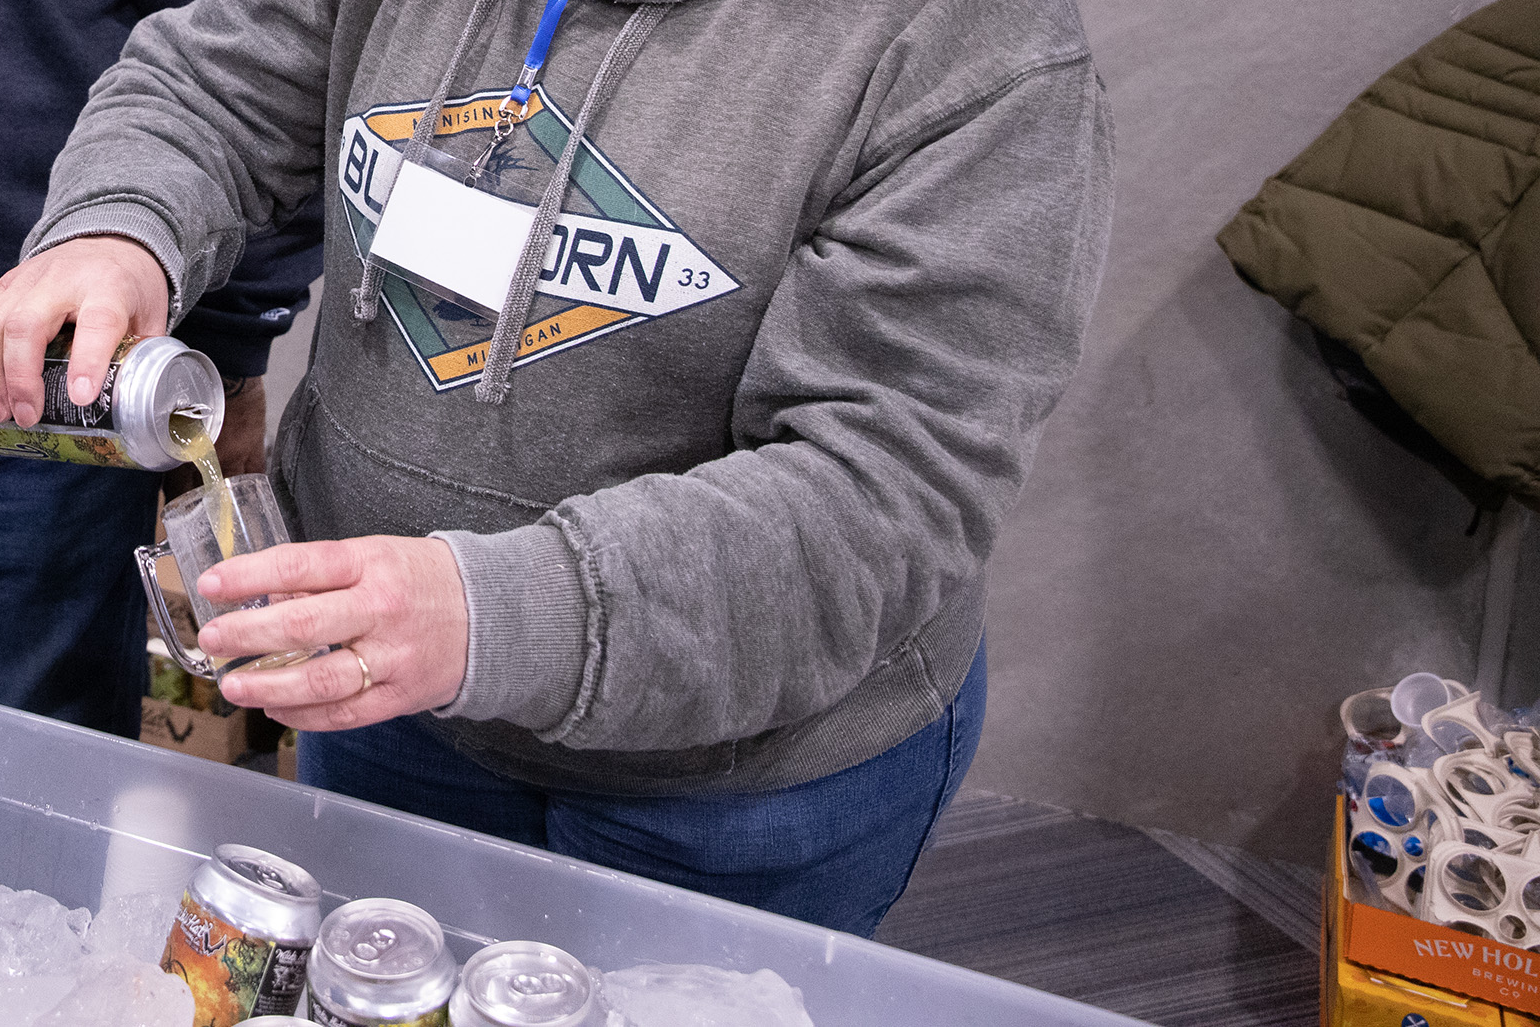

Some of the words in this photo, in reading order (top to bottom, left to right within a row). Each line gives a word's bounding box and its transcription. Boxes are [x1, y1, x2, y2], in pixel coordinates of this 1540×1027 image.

[677, 267, 712, 290] 33
[466, 322, 562, 367] MIIGAN
[1413, 939, 1474, 959] NEW
